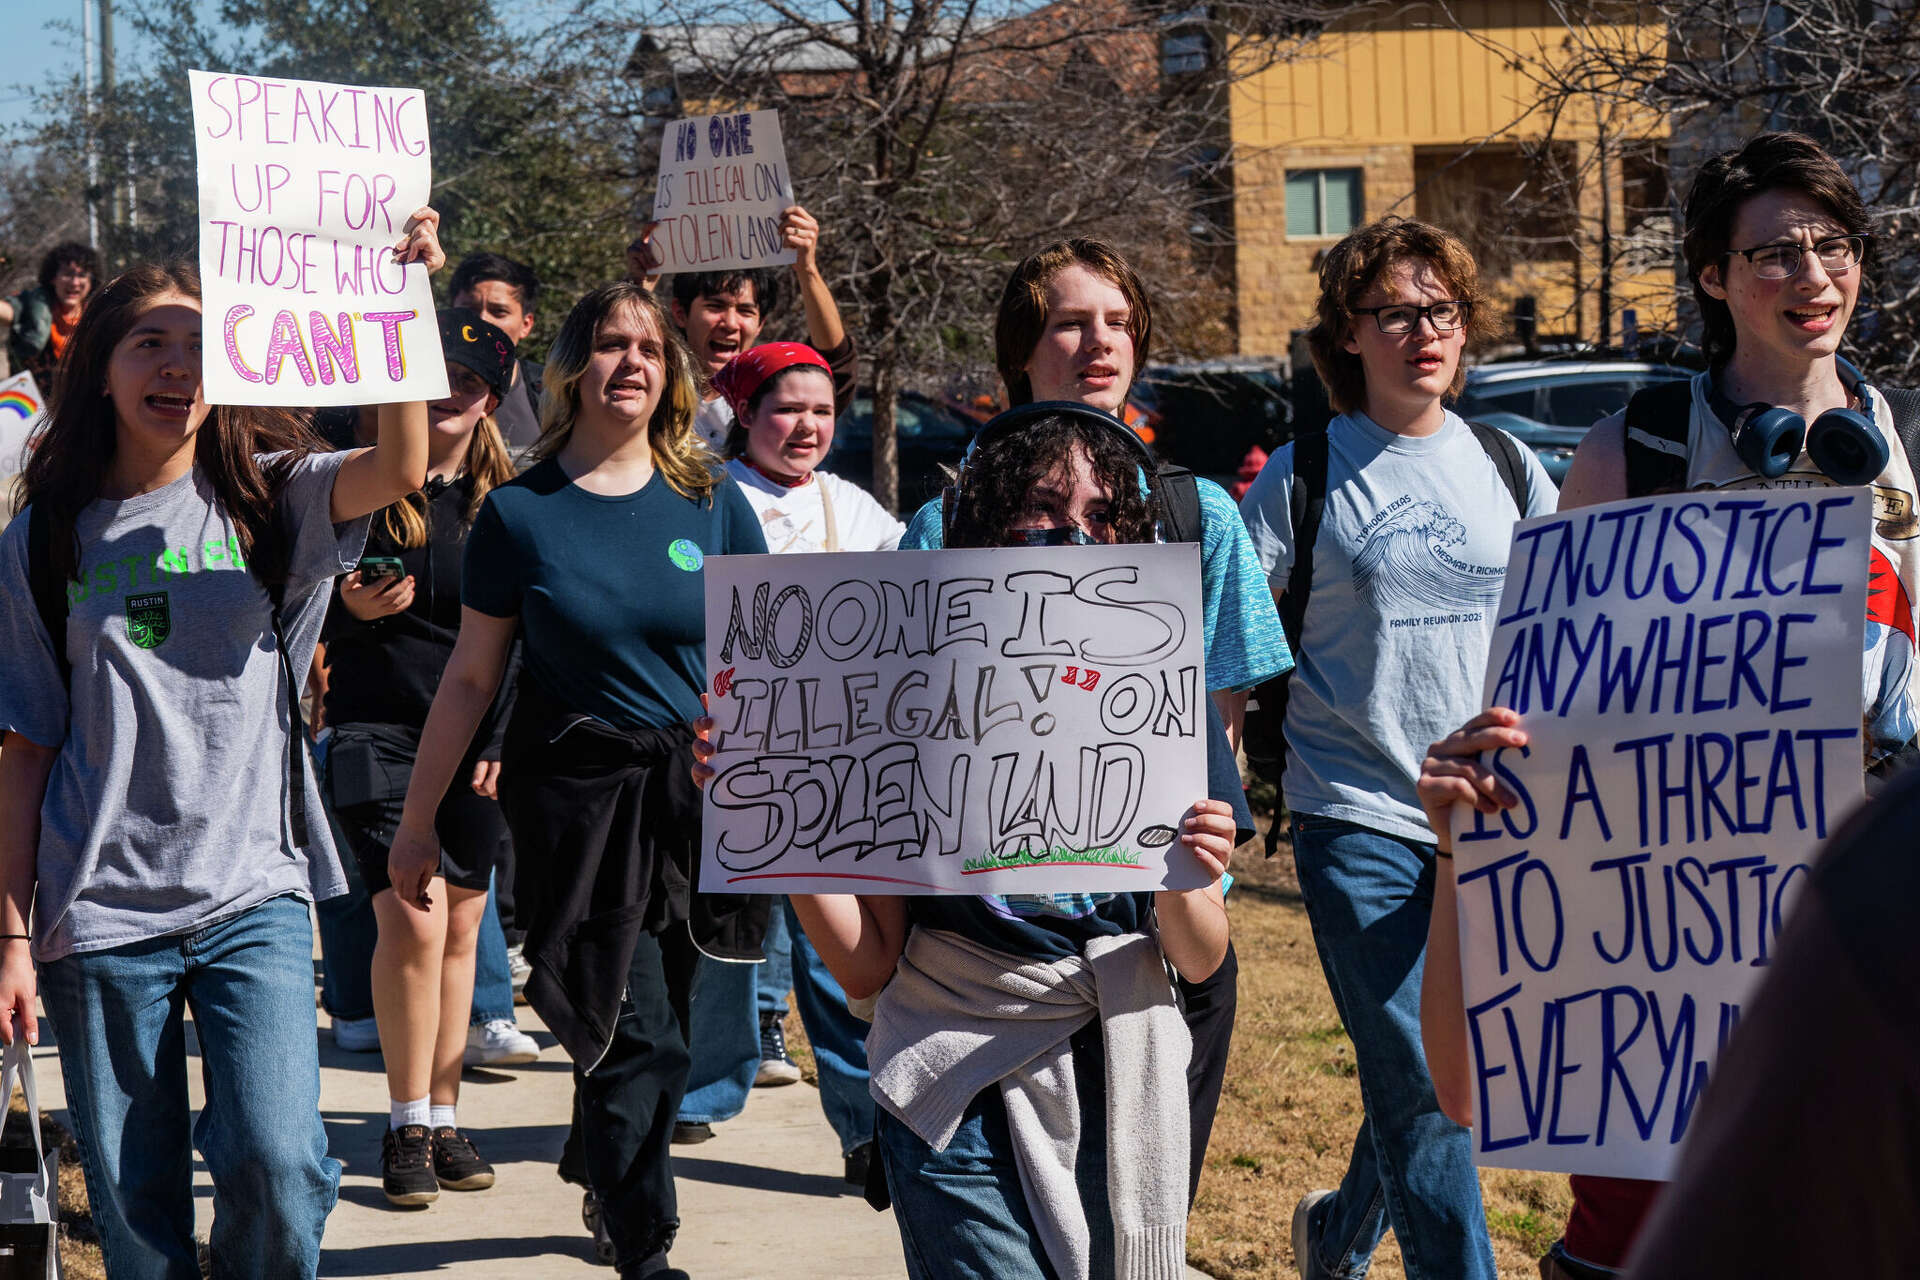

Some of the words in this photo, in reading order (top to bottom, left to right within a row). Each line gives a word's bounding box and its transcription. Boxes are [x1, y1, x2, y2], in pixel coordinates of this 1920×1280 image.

[207, 77, 425, 156] SPEAKING
[675, 121, 697, 162] NO
[708, 114, 754, 158] ONE
[231, 163, 291, 215] UP
[317, 170, 397, 234] FOR
[657, 173, 674, 209] IS
[684, 165, 750, 206] ILLEGAL
[754, 163, 783, 202] ON
[209, 220, 318, 294] THOSE
[333, 240, 407, 296] WHO
[651, 213, 734, 268] STOLEN
[736, 215, 784, 260] LAND
[224, 304, 418, 386] CAN'T
[1355, 509, 1389, 545] TYPHOON
[1387, 494, 1412, 513] TEXAS
[67, 545, 190, 611] USTIN
[1432, 544, 1468, 571] CHESMAR
[1467, 565, 1474, 574] X
[1475, 565, 1506, 576] RICHMO
[1498, 495, 1855, 626] INJUSTICE
[130, 596, 164, 608] AUSTIN
[1000, 566, 1186, 666] IS
[1389, 617, 1421, 628] FAMILY
[1423, 614, 1461, 626] REUNION
[1463, 612, 1482, 622] 2025
[1492, 609, 1817, 717] ANYWHERE
[1100, 666, 1198, 737] ON
[986, 743, 1178, 861] LAND.
[1558, 744, 1613, 842] A
[1613, 727, 1859, 848] THREAT
[1456, 849, 1565, 976] TO
[1590, 853, 1812, 973] JUSTIC
[1466, 982, 1741, 1152] EVERYW
